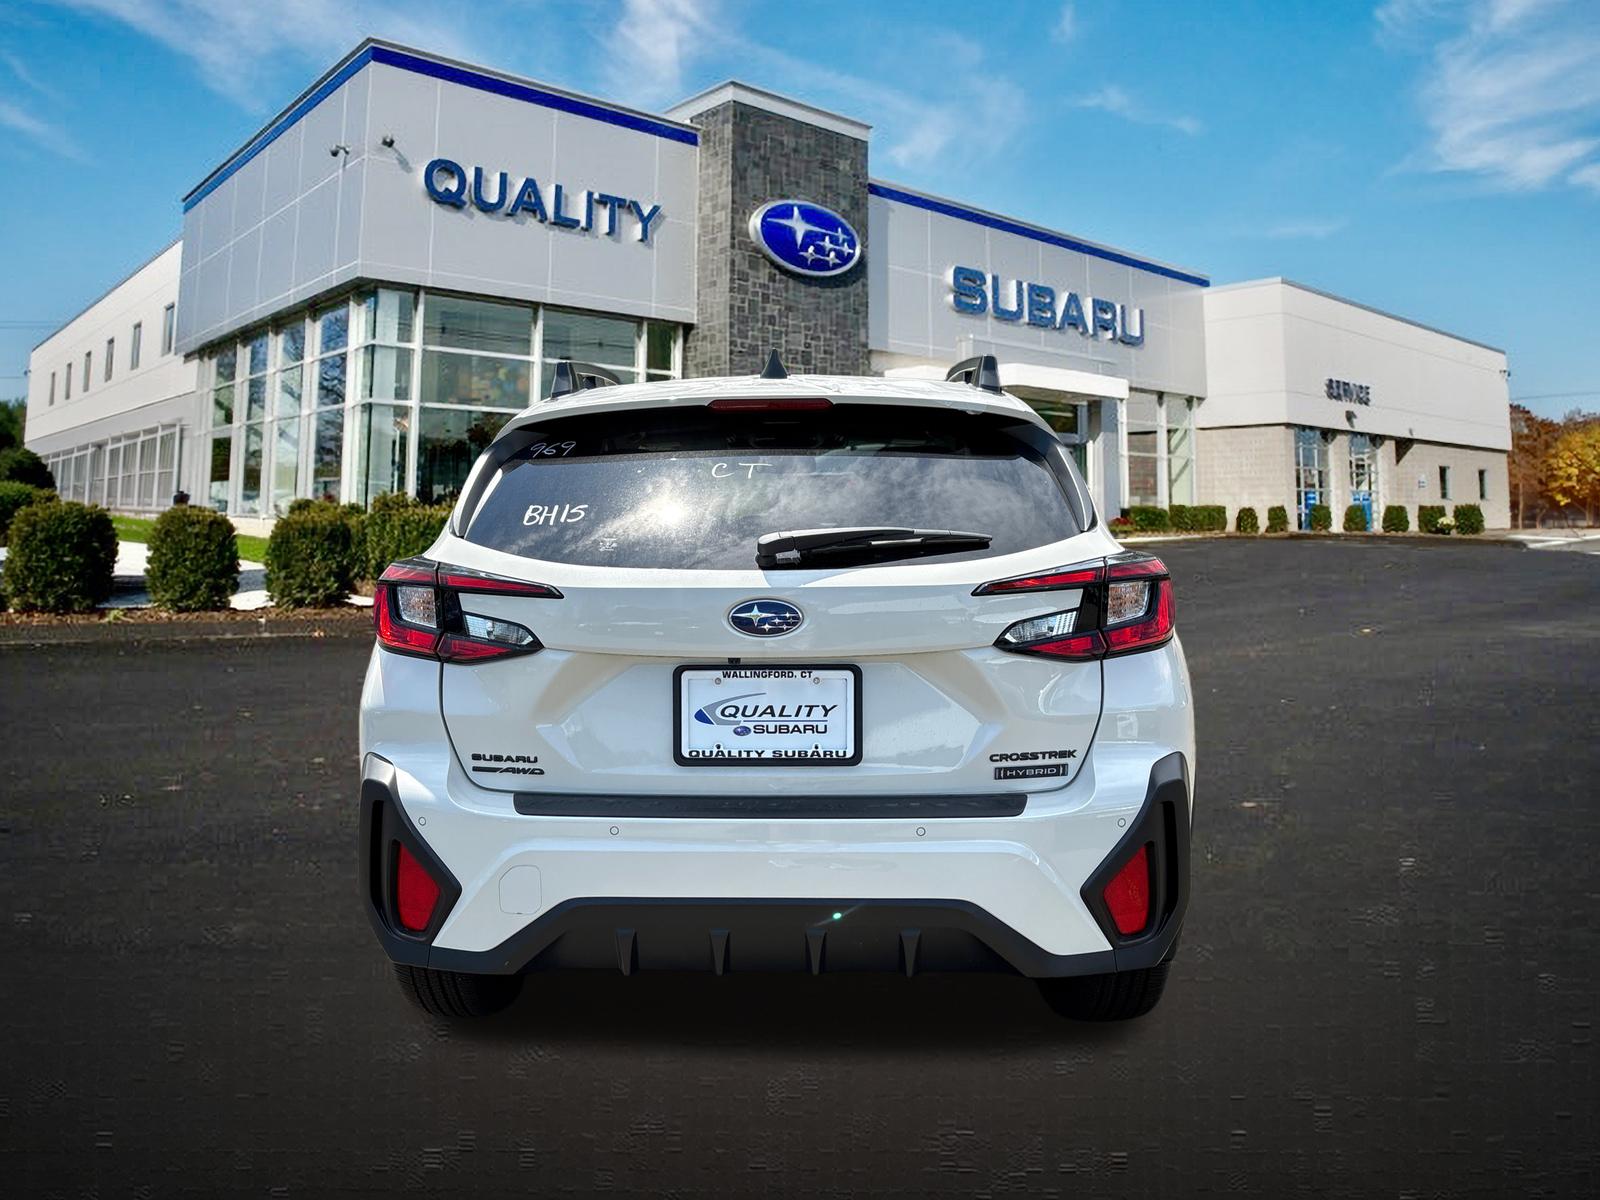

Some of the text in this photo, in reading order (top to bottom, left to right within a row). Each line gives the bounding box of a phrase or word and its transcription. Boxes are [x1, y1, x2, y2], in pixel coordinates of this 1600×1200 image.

[424, 158, 661, 242] QUALITY
[951, 265, 1145, 346] SUBARU
[530, 441, 576, 458] 969
[801, 671, 813, 679] CT
[720, 705, 838, 719] QUALITY
[753, 724, 828, 734] SUBARU
[471, 753, 538, 763] SUBARU
[688, 750, 847, 758] QUALITY SUBARU
[989, 750, 1077, 762] CROSSTREK
[499, 767, 545, 775] AWD
[1007, 767, 1057, 777] HYBRID
